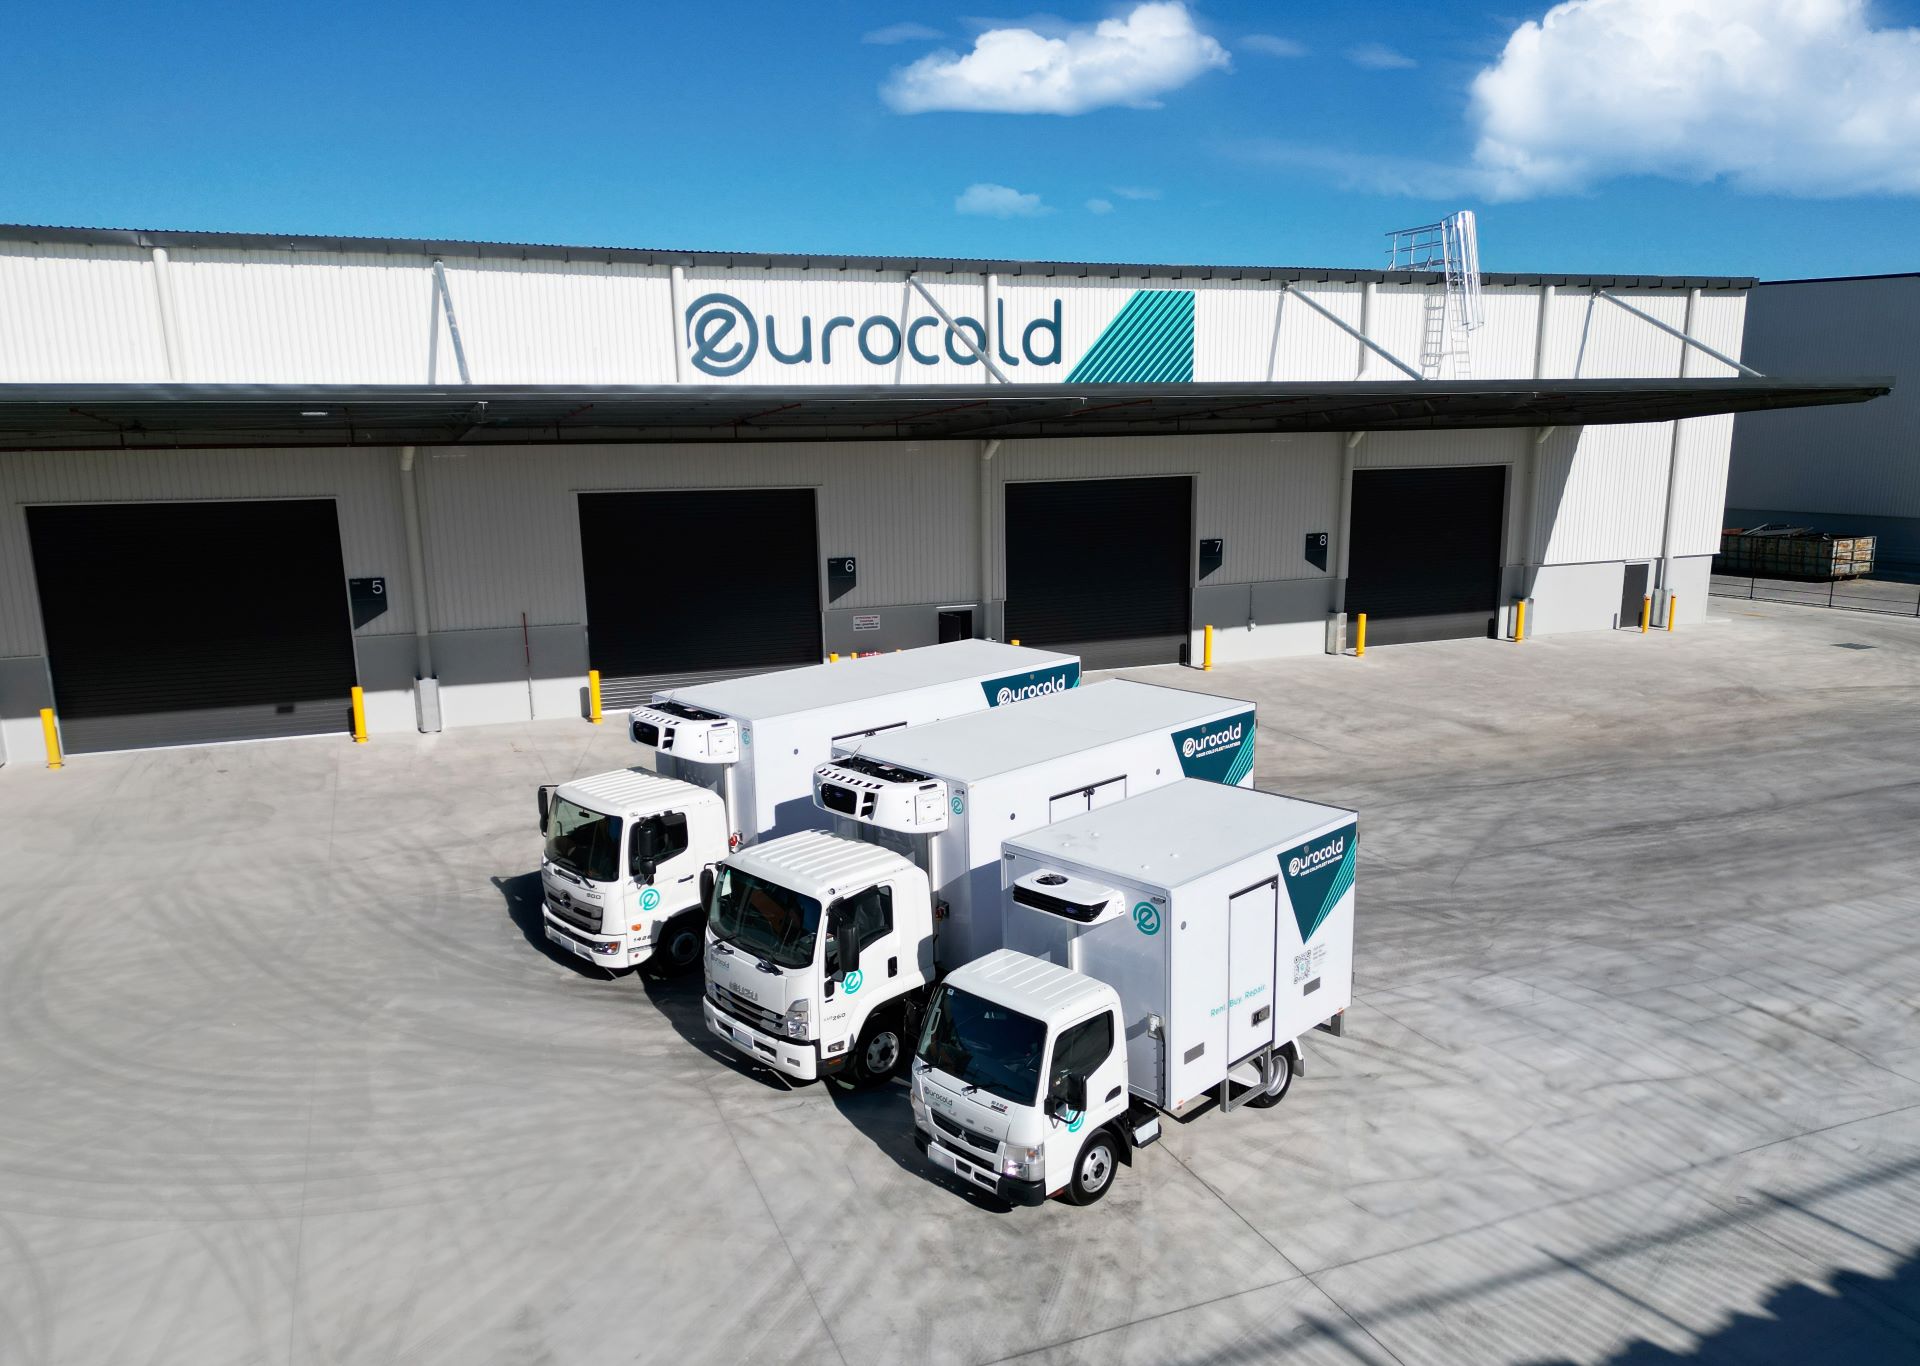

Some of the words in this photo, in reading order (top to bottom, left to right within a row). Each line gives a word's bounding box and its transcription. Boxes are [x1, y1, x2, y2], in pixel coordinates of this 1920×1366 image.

[685, 293, 1062, 377] eurocold
[1214, 540, 1222, 552] 7
[1319, 534, 1327, 546] 8
[845, 559, 854, 572] 6
[372, 580, 383, 594] 5
[997, 674, 1066, 706] eurocold
[1182, 722, 1242, 758] eurocold
[1289, 836, 1344, 877] eurocold
